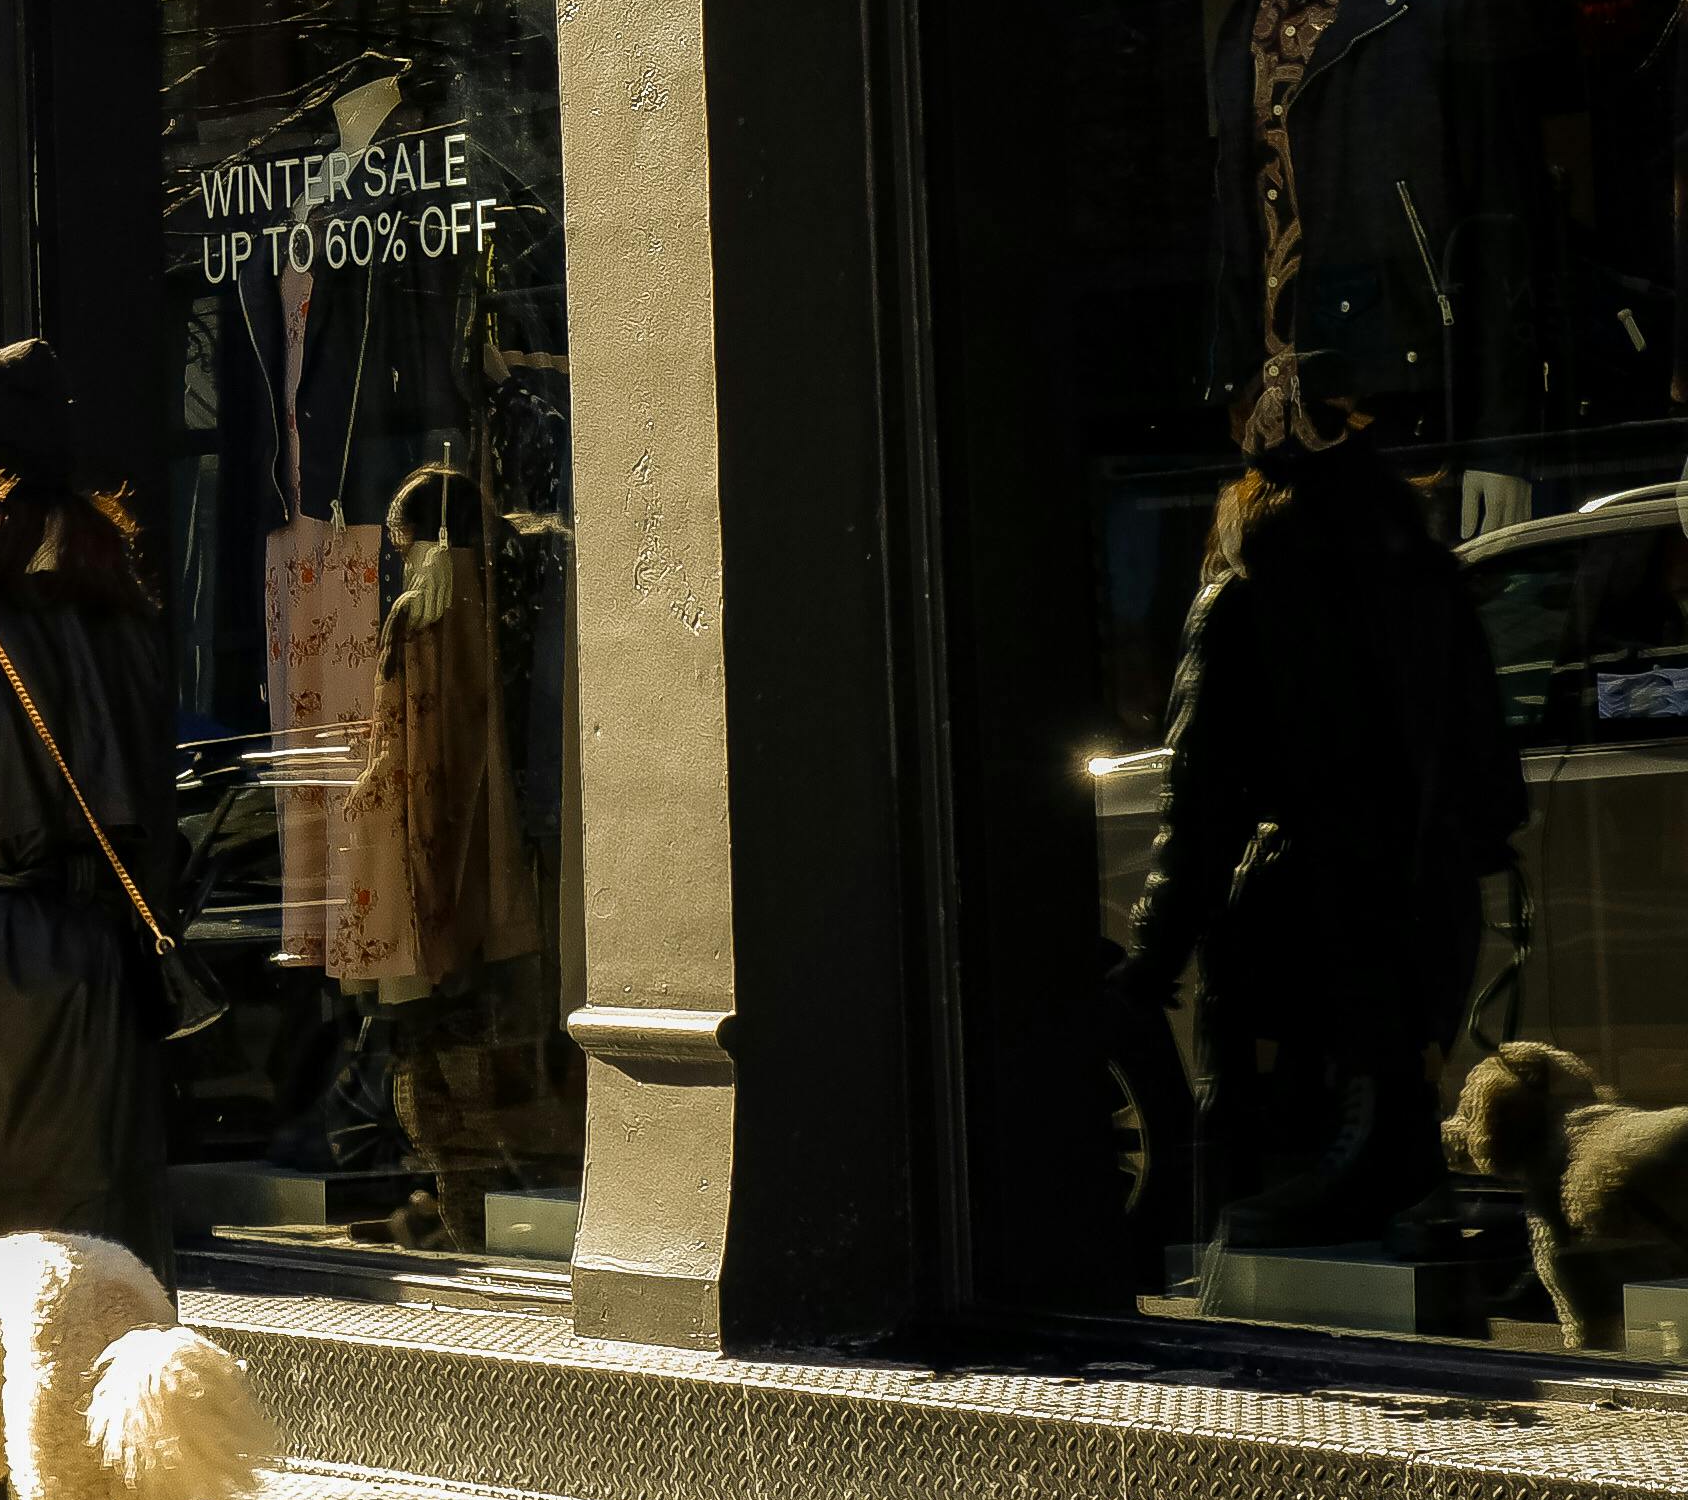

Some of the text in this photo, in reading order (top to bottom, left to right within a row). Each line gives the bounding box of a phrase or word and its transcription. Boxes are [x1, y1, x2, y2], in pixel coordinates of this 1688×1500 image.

[200, 133, 467, 219] WINTER SALE
[203, 198, 497, 284] UP TO 60% OFF
